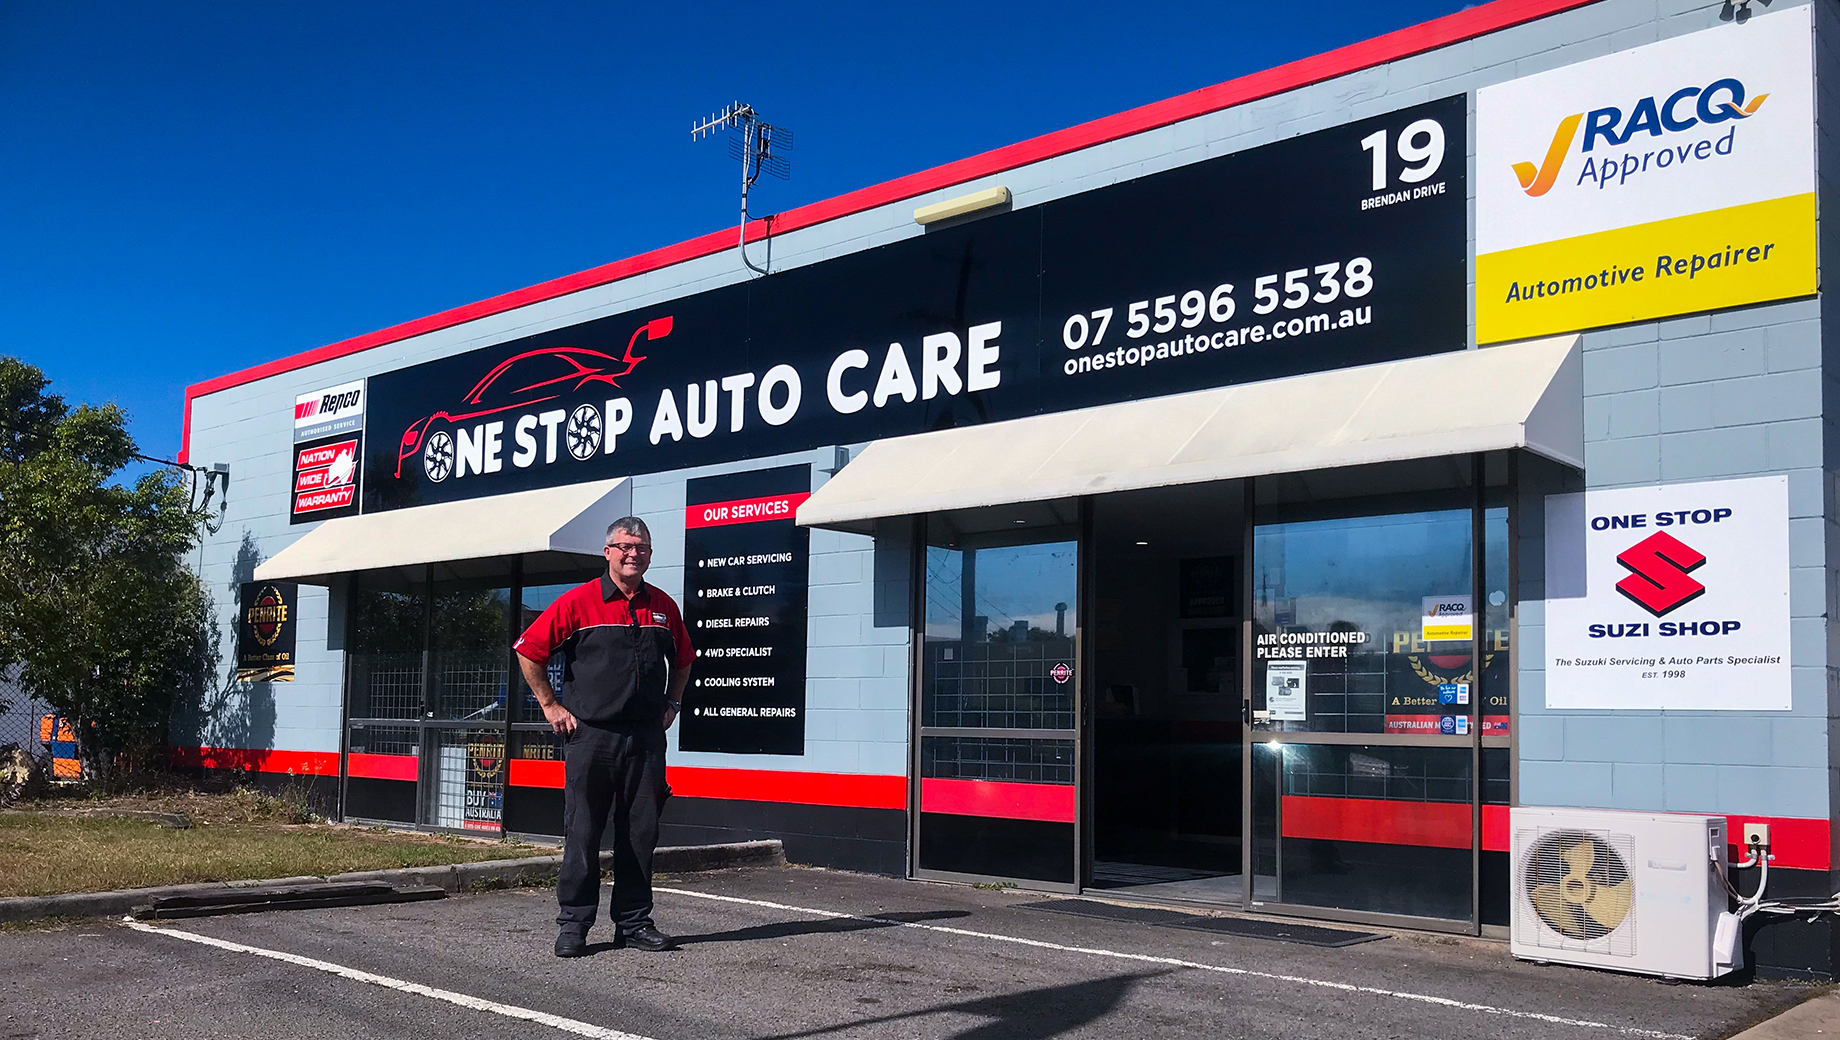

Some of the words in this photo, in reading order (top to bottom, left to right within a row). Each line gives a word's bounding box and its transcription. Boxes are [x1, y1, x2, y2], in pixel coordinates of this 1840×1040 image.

[1581, 77, 1769, 154] RACQ
[1360, 118, 1446, 191] 19
[1576, 125, 1736, 189] Approved
[1361, 188, 1410, 210] BRENDAN
[1413, 182, 1446, 200] DRIVE
[1505, 264, 1644, 304] Automotive
[1655, 242, 1775, 278] Repairer
[1062, 308, 1114, 350] 07
[1126, 284, 1236, 338] 5596
[1252, 257, 1374, 316] 5538
[1063, 305, 1372, 376] onestopautocare.com.au
[319, 390, 360, 415] Repco
[424, 420, 504, 483] ONE
[512, 397, 632, 468] STOP
[650, 364, 802, 445] AUTO
[826, 320, 1002, 414] CARE
[301, 425, 332, 437] AUTHORISED
[334, 420, 356, 430] SERVICE
[301, 449, 336, 465] NATION
[300, 474, 322, 486] WIDE
[299, 490, 352, 508] WARRANTY
[704, 507, 728, 521] OUR
[732, 500, 789, 518] SERVICES
[1590, 514, 1647, 530] ONE
[1655, 508, 1732, 527] STOP
[708, 558, 726, 568] NEW
[728, 556, 745, 566] CAR
[746, 553, 792, 565] SERVICING
[706, 588, 733, 598] BRAKE
[735, 588, 741, 596] &
[743, 585, 775, 595] CLUTCH
[248, 604, 288, 624] PENRITE
[1439, 603, 1466, 611] RACQ
[706, 618, 733, 628] DIESEL
[735, 617, 770, 627] REPAIRS
[1588, 623, 1649, 638] SUZI
[1658, 620, 1741, 636] SHOP
[1257, 634, 1277, 645] AIR
[1280, 632, 1366, 644] CONDITIONED
[705, 648, 724, 657] 4WD
[726, 647, 772, 657] SPECIALIST
[1257, 647, 1302, 658] PLEASE
[1306, 646, 1347, 658] ENTER
[1575, 658, 1607, 666] Suzuki
[1609, 657, 1656, 667] Servicing
[1696, 656, 1724, 664] Parts
[1726, 655, 1781, 665] Specialist
[704, 677, 741, 687] COOLING
[742, 677, 775, 686] SYSTEM
[1392, 697, 1400, 705] A
[1403, 697, 1437, 705] Better
[1490, 697, 1507, 705] Oil
[703, 707, 718, 716] ALL
[720, 708, 758, 717] GENERAL
[760, 708, 796, 717] REPAIRS
[466, 790, 486, 806] BUY
